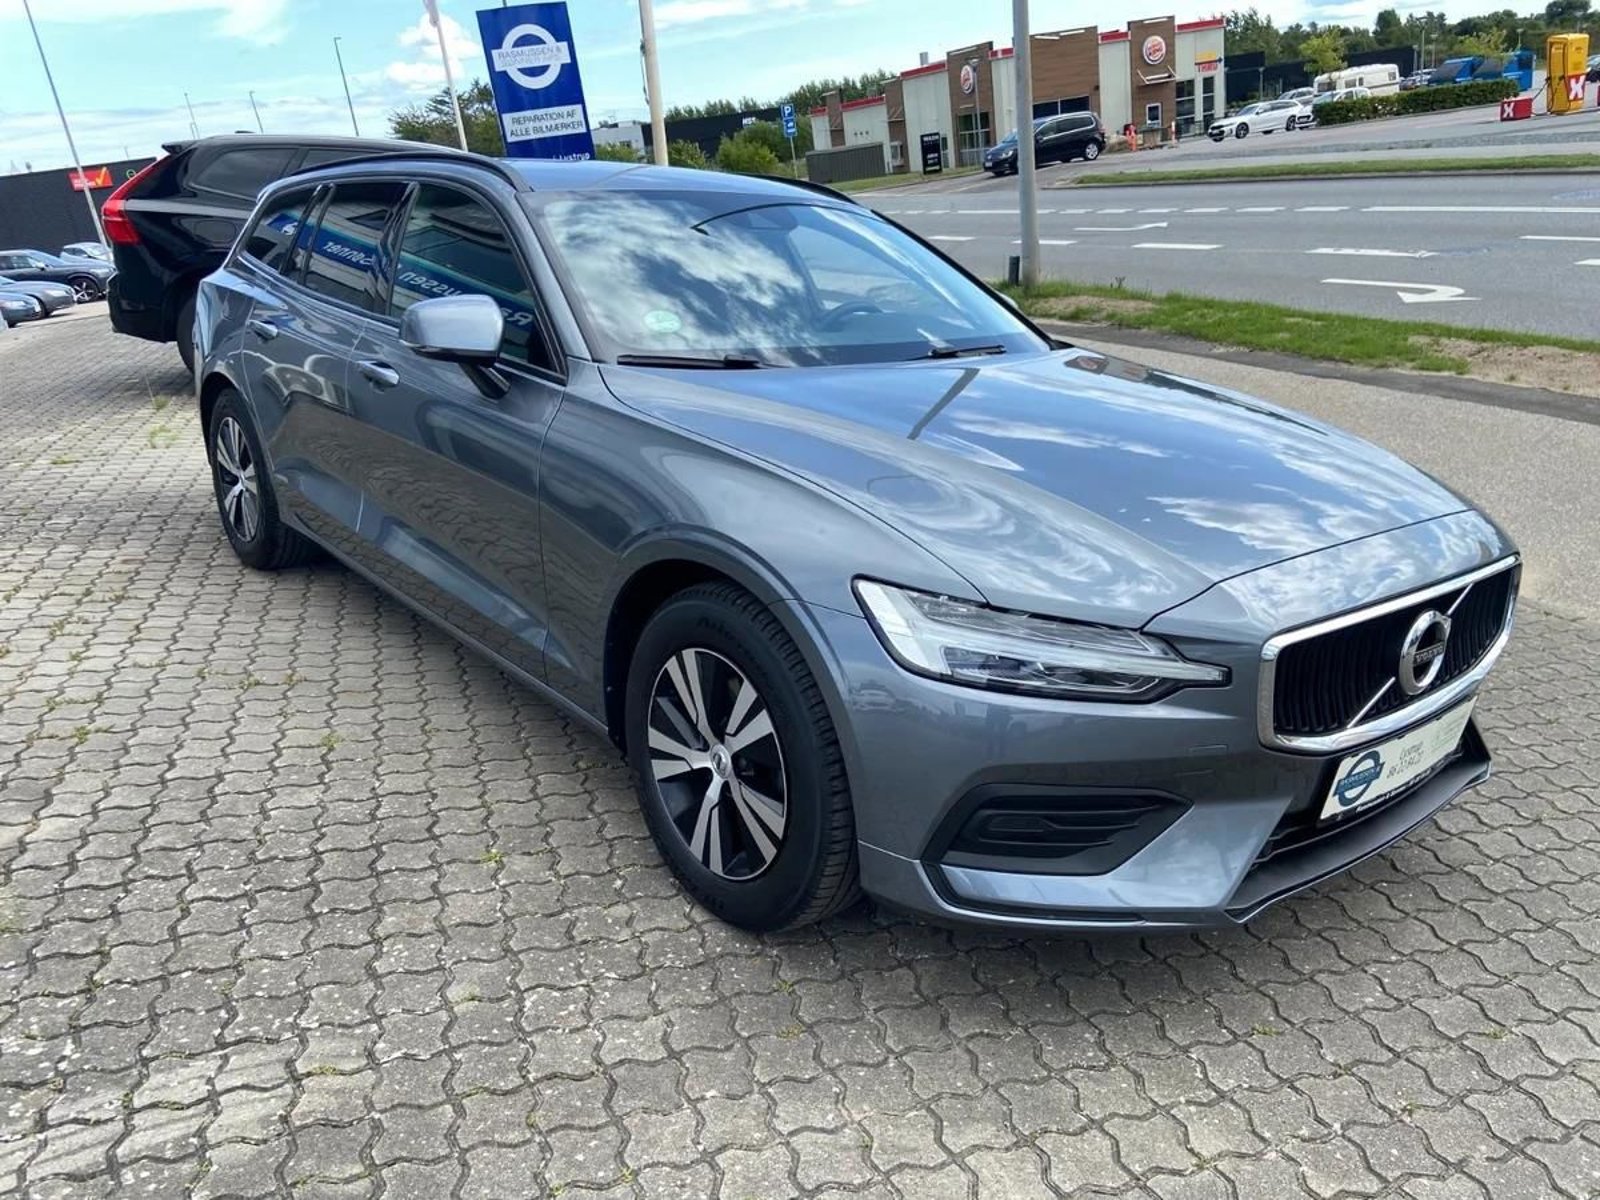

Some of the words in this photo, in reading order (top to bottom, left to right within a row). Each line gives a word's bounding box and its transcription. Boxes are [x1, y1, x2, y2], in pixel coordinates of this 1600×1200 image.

[1569, 74, 1586, 100] X
[511, 112, 565, 126] REPARATION
[566, 109, 577, 119] AF
[784, 105, 791, 116] P
[1503, 102, 1515, 118] X
[510, 127, 532, 138] ALLE
[532, 120, 583, 136] BILMÆRKER
